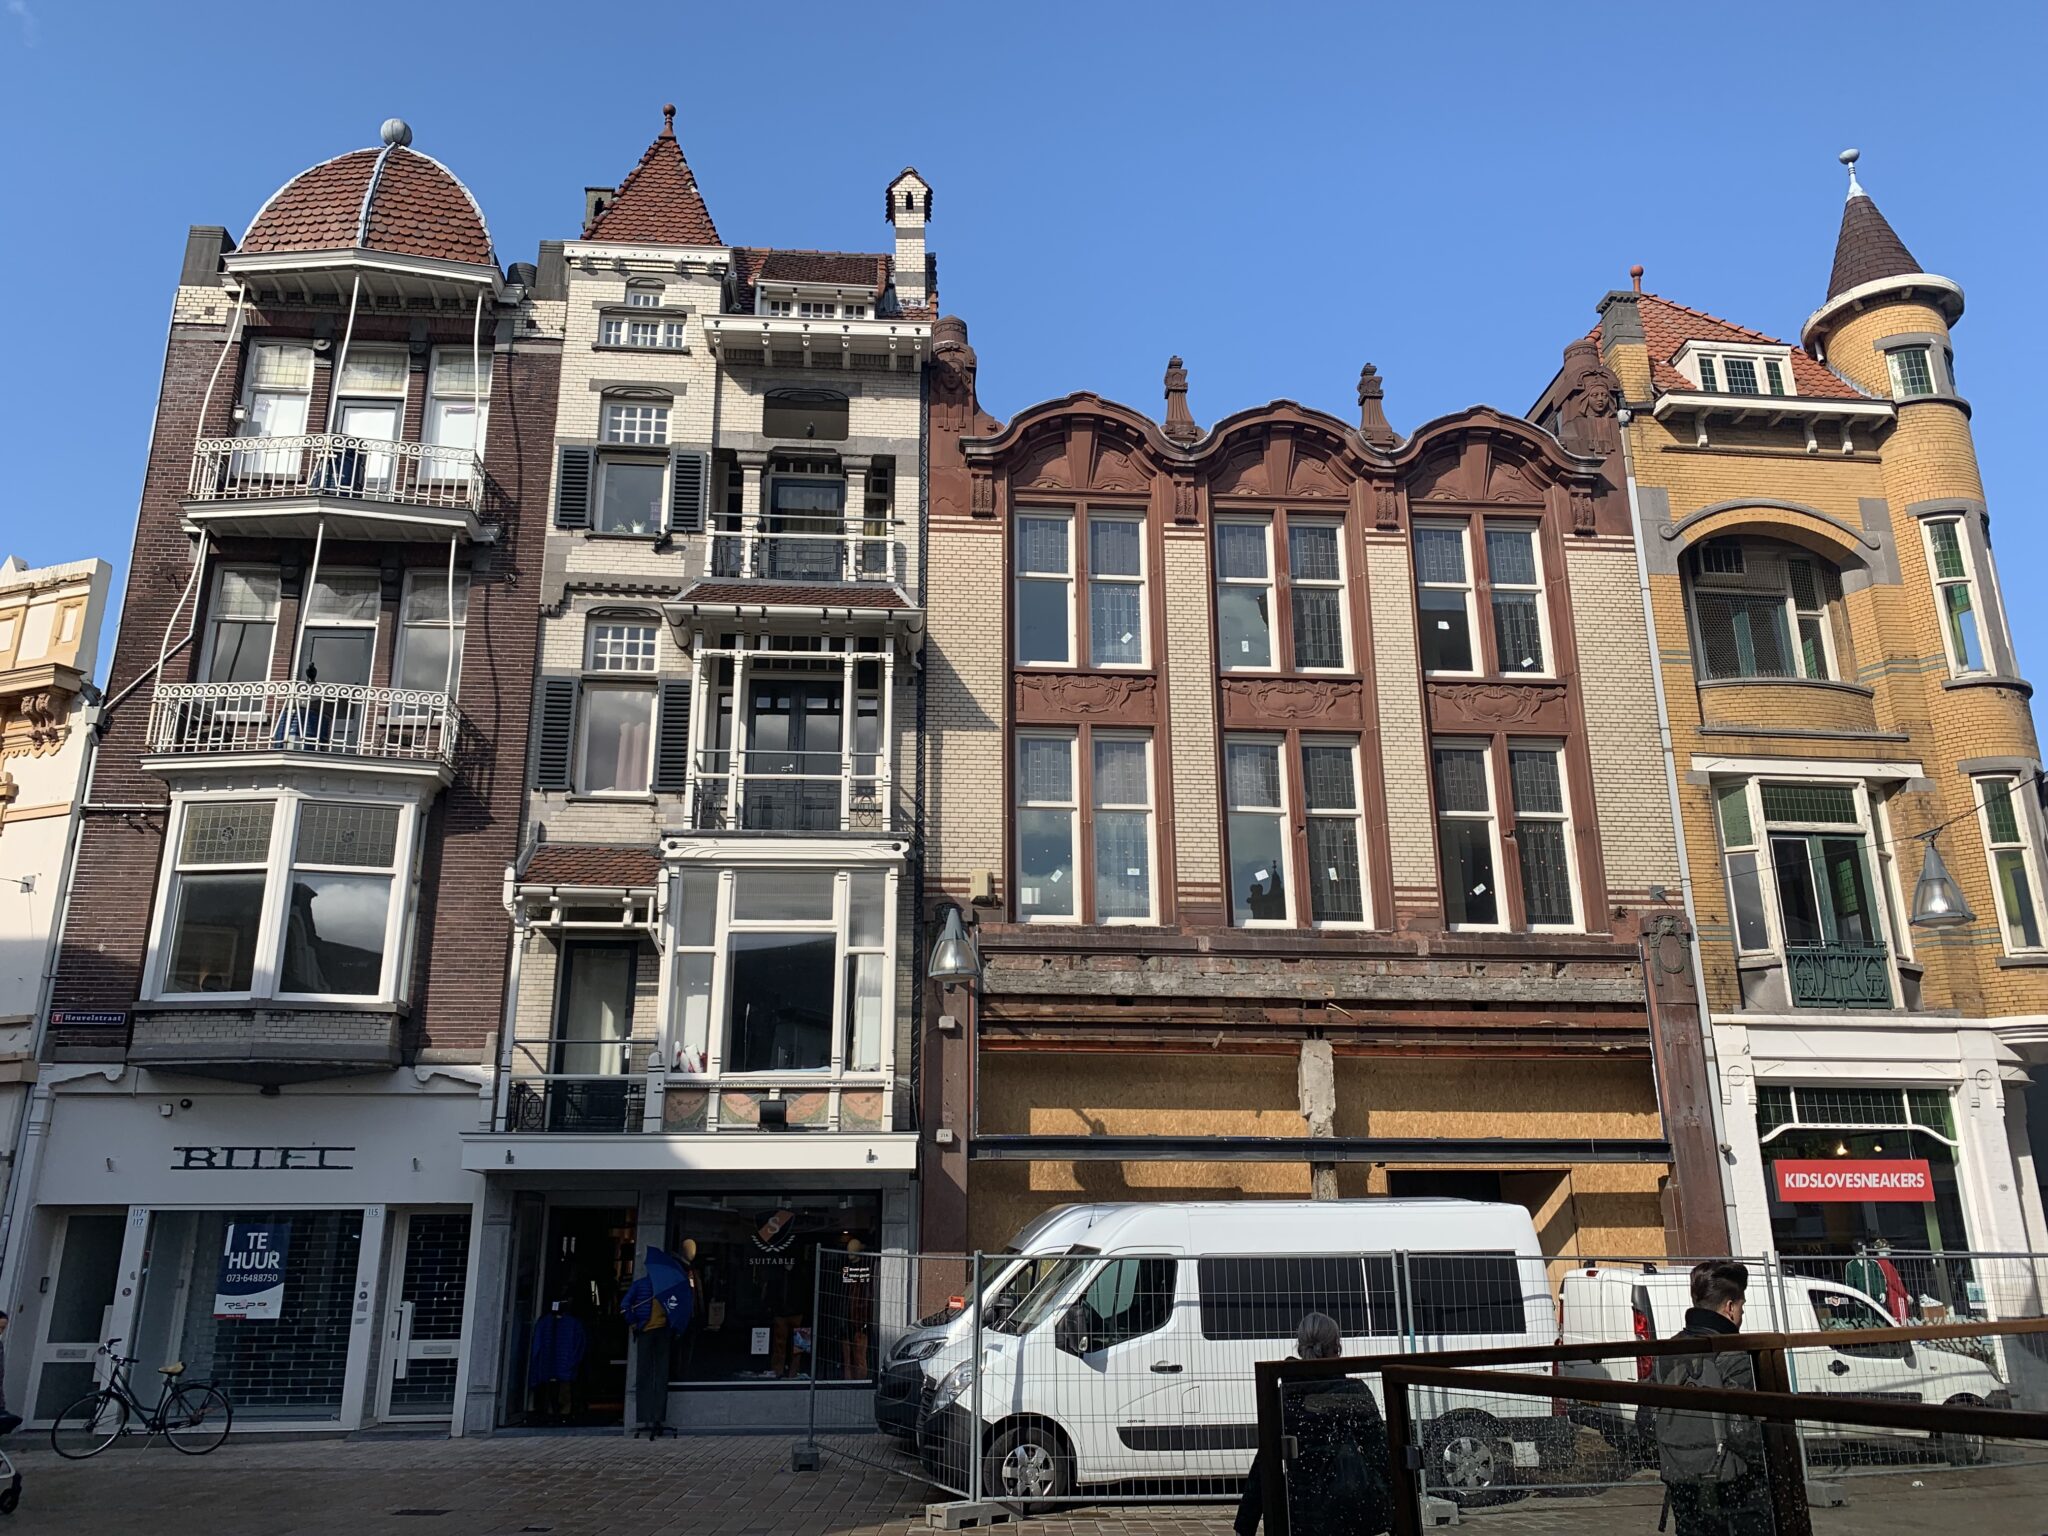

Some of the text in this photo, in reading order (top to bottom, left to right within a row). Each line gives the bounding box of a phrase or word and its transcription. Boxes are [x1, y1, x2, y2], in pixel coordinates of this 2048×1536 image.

[1785, 1172, 1925, 1188] KIDSLOVESNEAKERS
[247, 1232, 268, 1249] TE
[228, 1251, 280, 1269] HUUR
[749, 1257, 796, 1265] SUITABLE
[226, 1274, 278, 1282] 073-6488750
